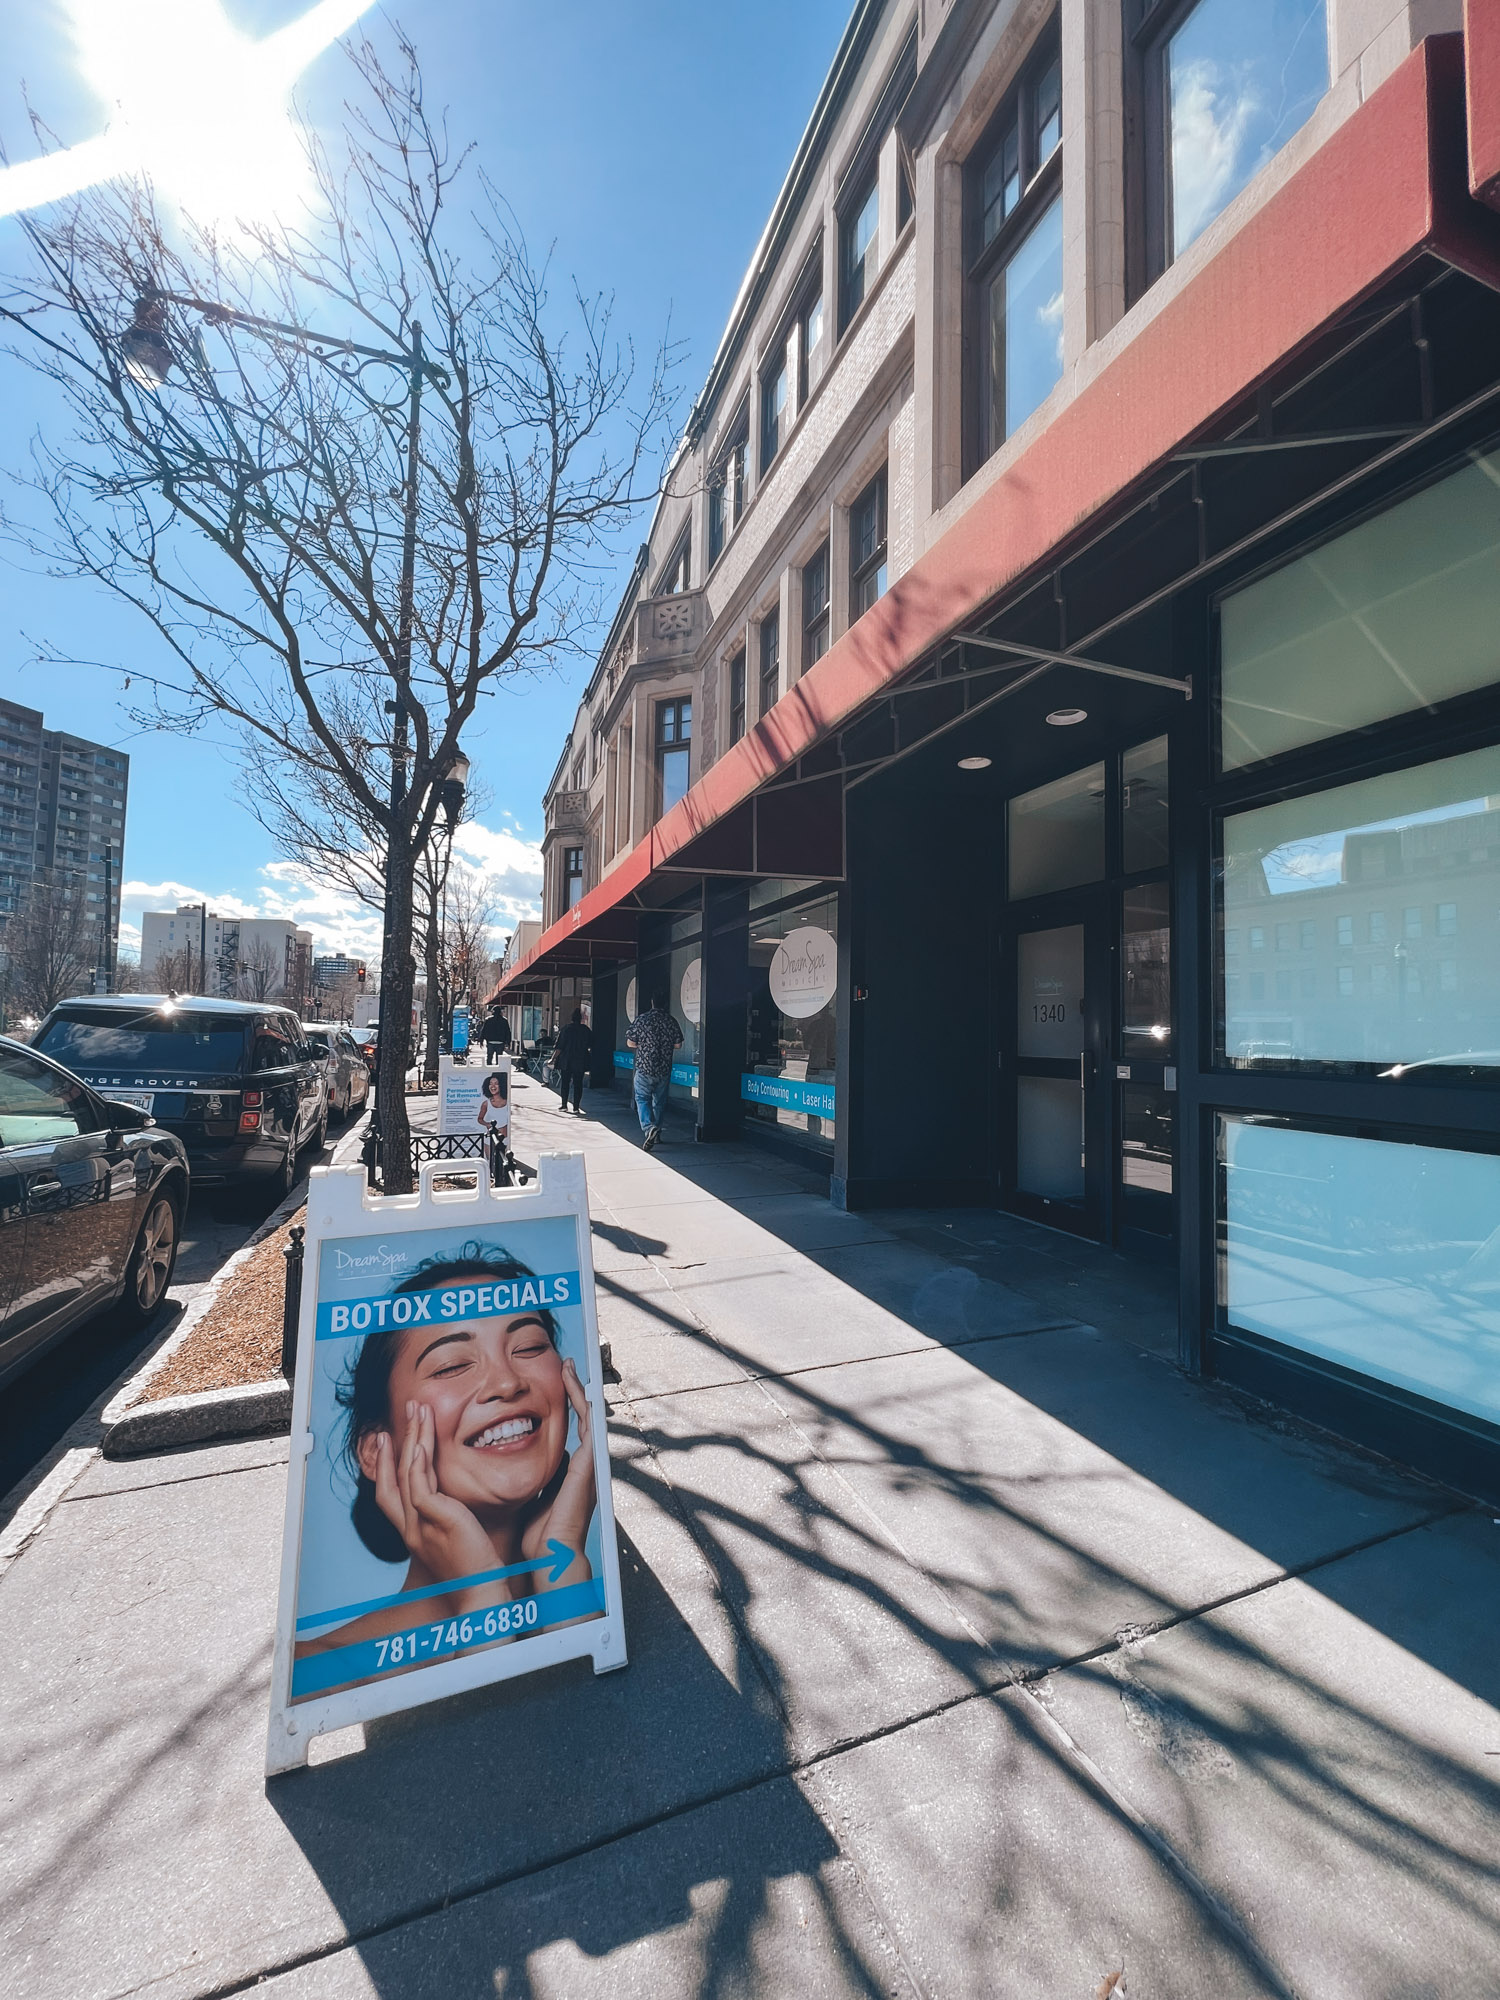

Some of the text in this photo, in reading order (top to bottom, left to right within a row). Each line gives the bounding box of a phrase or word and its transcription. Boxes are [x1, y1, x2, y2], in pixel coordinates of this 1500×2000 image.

[1032, 1004, 1065, 1023] 1340
[84, 1077, 199, 1087] NGE ROVER
[747, 1080, 835, 1111] Body Contouring Laser Hai
[331, 1277, 569, 1333] BOTOX SPECIALS
[375, 1600, 538, 1667] 781-746-6830
